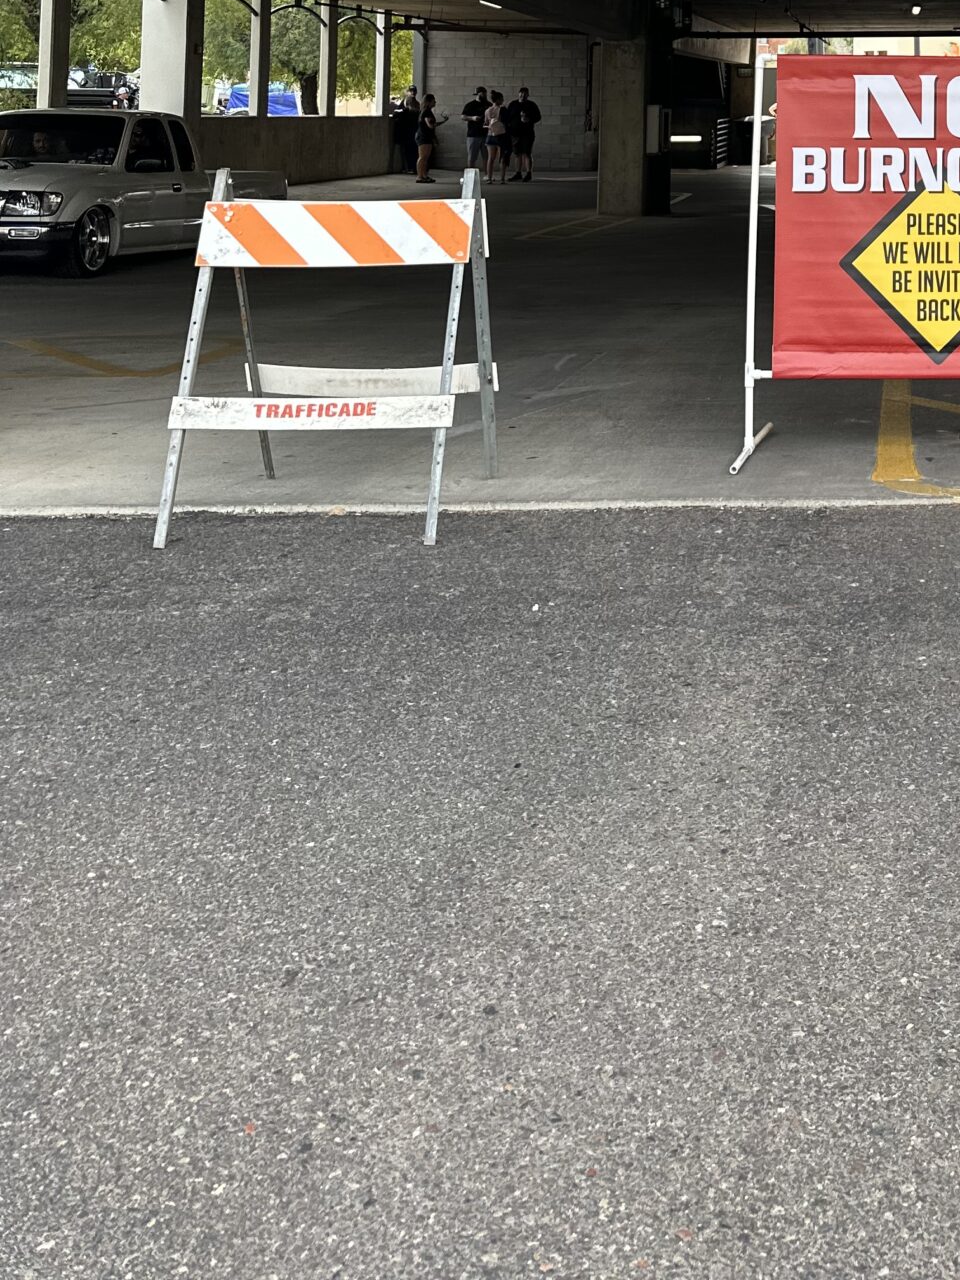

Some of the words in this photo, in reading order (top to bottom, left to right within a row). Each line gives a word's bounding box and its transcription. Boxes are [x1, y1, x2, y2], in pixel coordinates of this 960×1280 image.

[882, 241, 908, 264] WE
[913, 241, 954, 264] WILL
[891, 270, 913, 293] BE
[916, 299, 960, 322] BACK
[253, 401, 377, 418] TRAFFICADE
